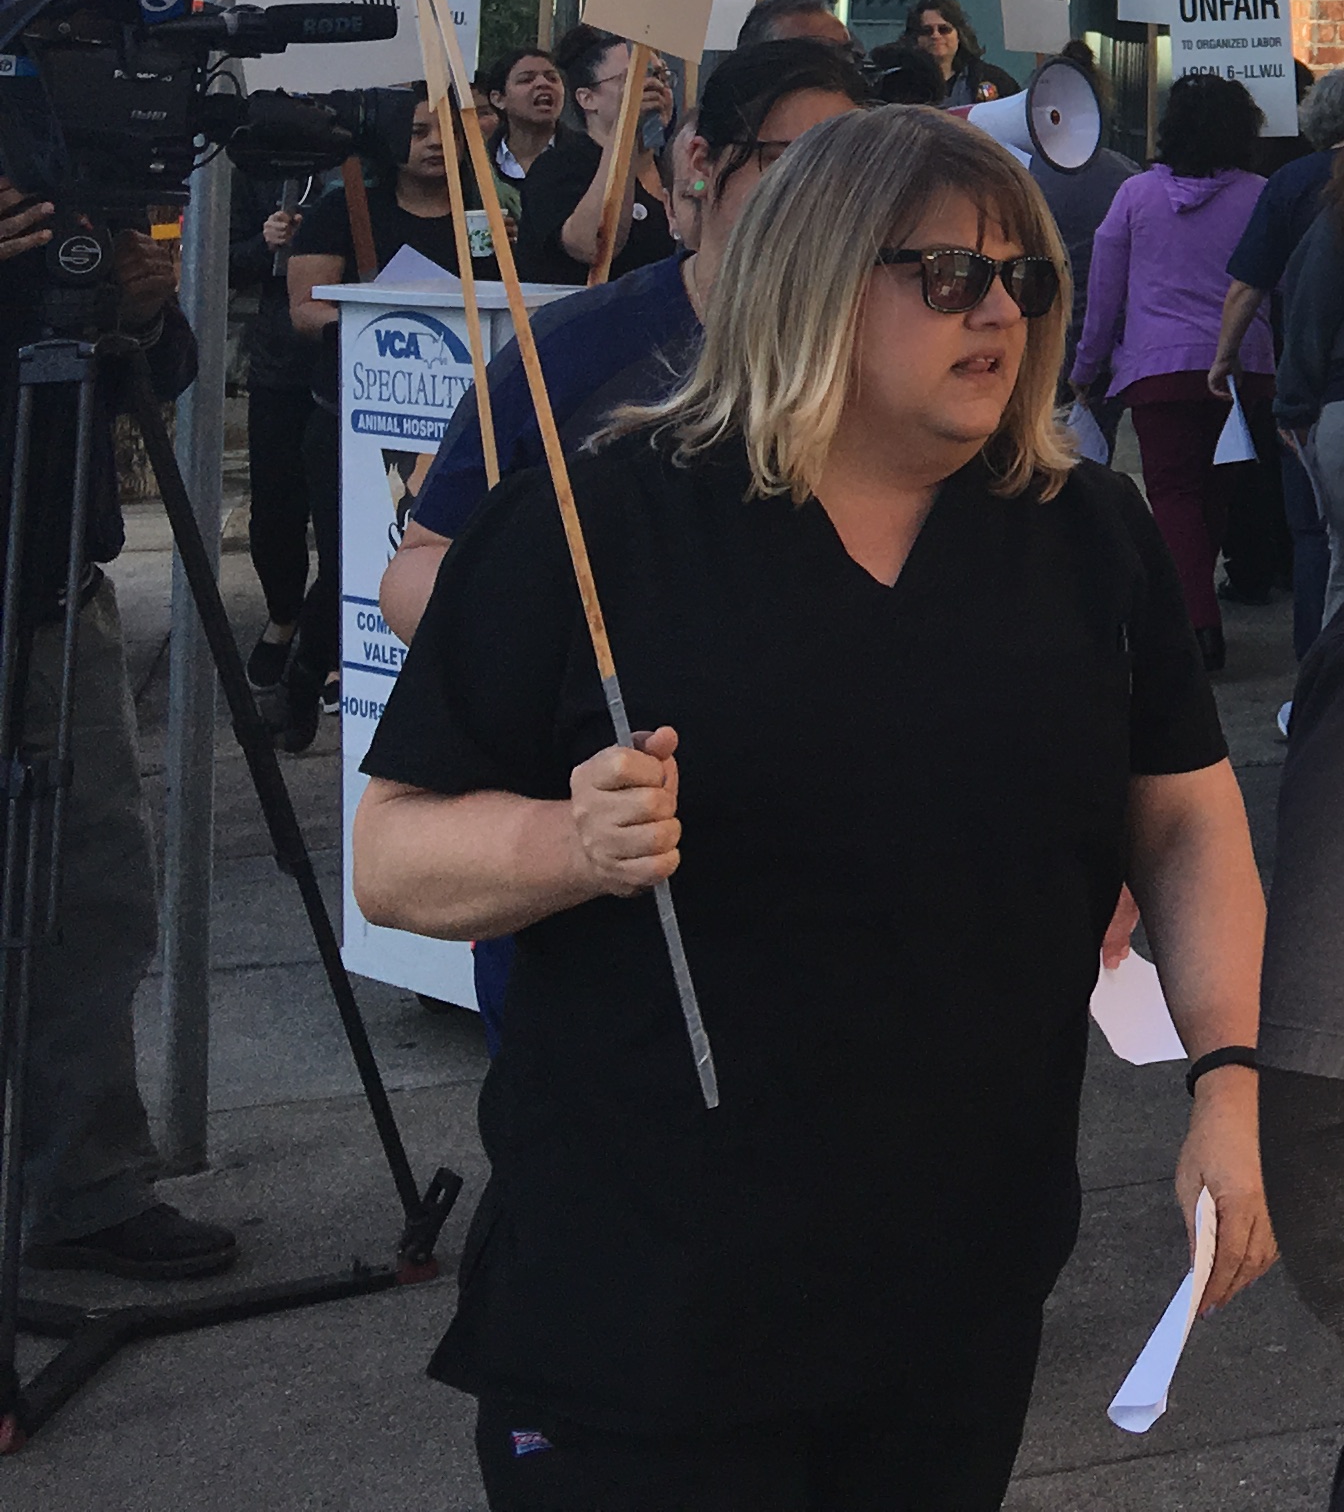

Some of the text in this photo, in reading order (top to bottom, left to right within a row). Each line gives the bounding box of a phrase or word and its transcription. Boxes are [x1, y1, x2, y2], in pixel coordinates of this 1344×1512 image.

[1182, 37, 1282, 50] TO ORGANIZED LABOR
[375, 329, 421, 360] VCA
[358, 414, 448, 438] ANIMAL HOSPIT
[363, 641, 407, 665] VALET
[342, 697, 385, 721] HOURS
